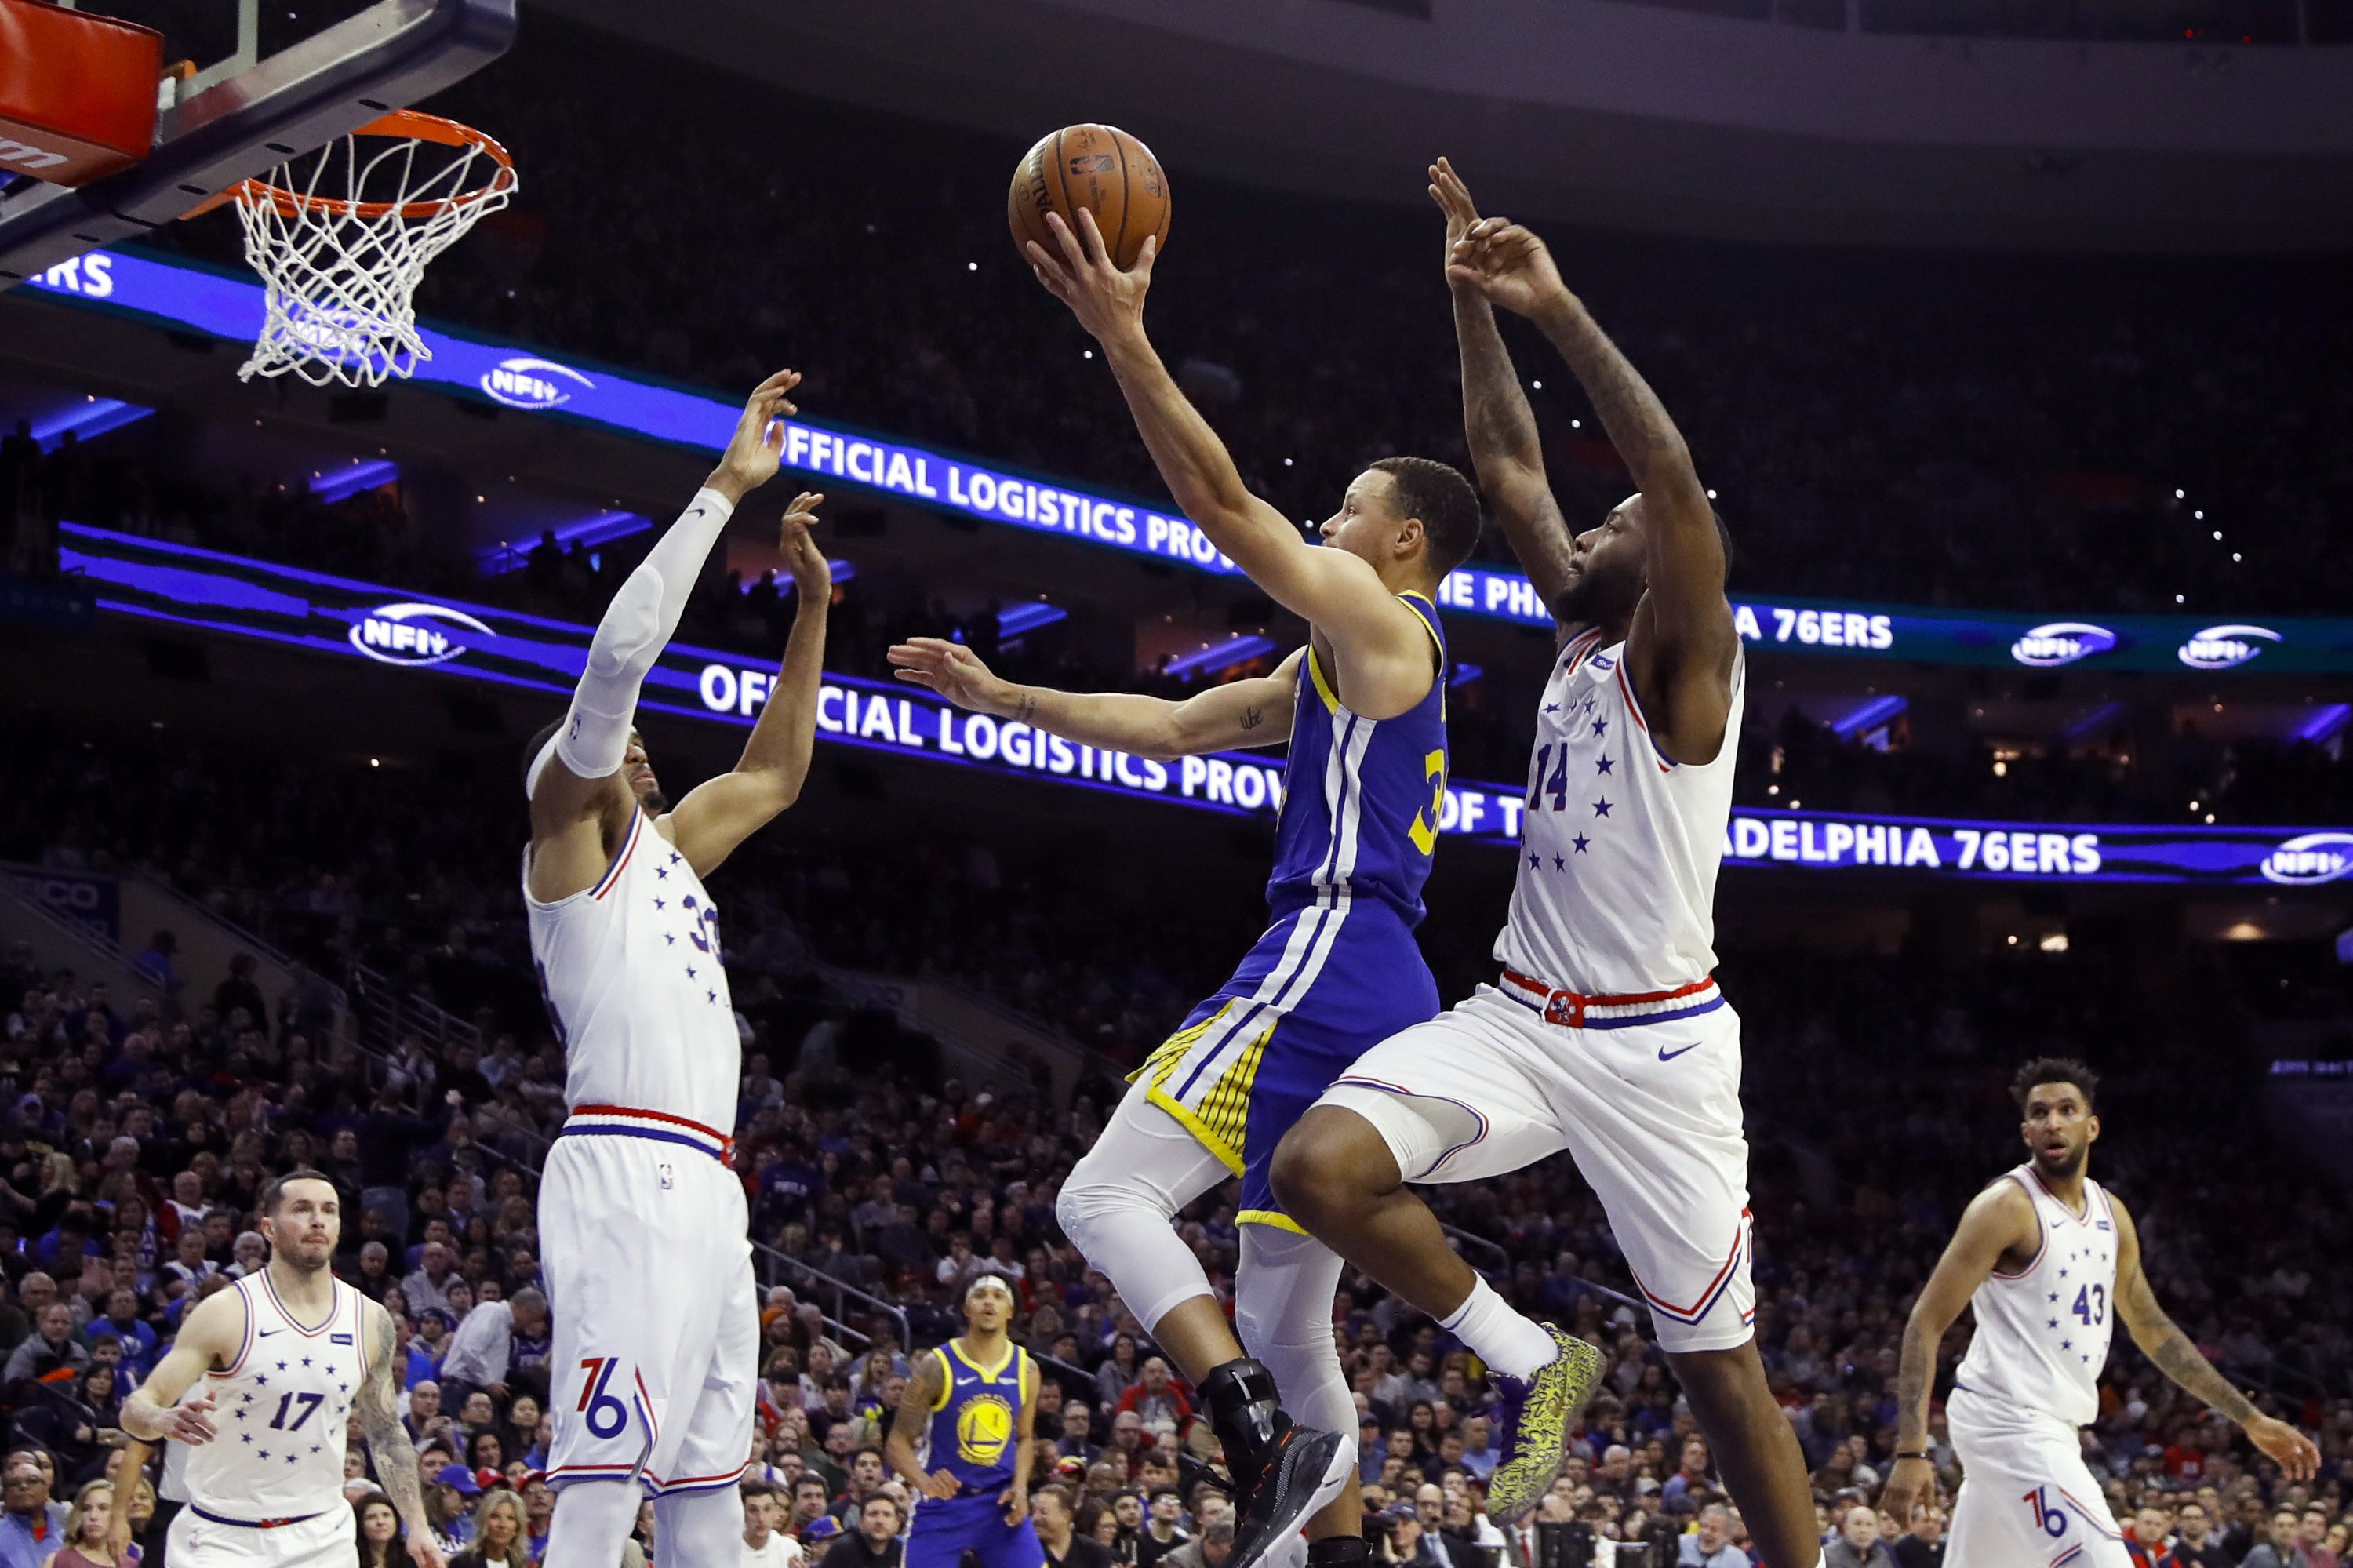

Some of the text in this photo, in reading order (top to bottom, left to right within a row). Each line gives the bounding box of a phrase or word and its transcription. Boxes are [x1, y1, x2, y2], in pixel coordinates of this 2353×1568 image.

[947, 465, 1136, 545] LOGISTICS
[1147, 514, 1235, 569] PRO
[1486, 577, 1554, 620] PHI
[1772, 607, 1893, 649] 76ERS
[363, 617, 430, 655] NFI
[699, 664, 924, 746] OFCIAL
[1953, 829, 2101, 874] 76ERS
[1529, 742, 1568, 812] 14
[2072, 1283, 2104, 1326] 43
[269, 1391, 325, 1432] 17
[576, 1356, 628, 1439] 76
[2023, 1485, 2068, 1538] 76
